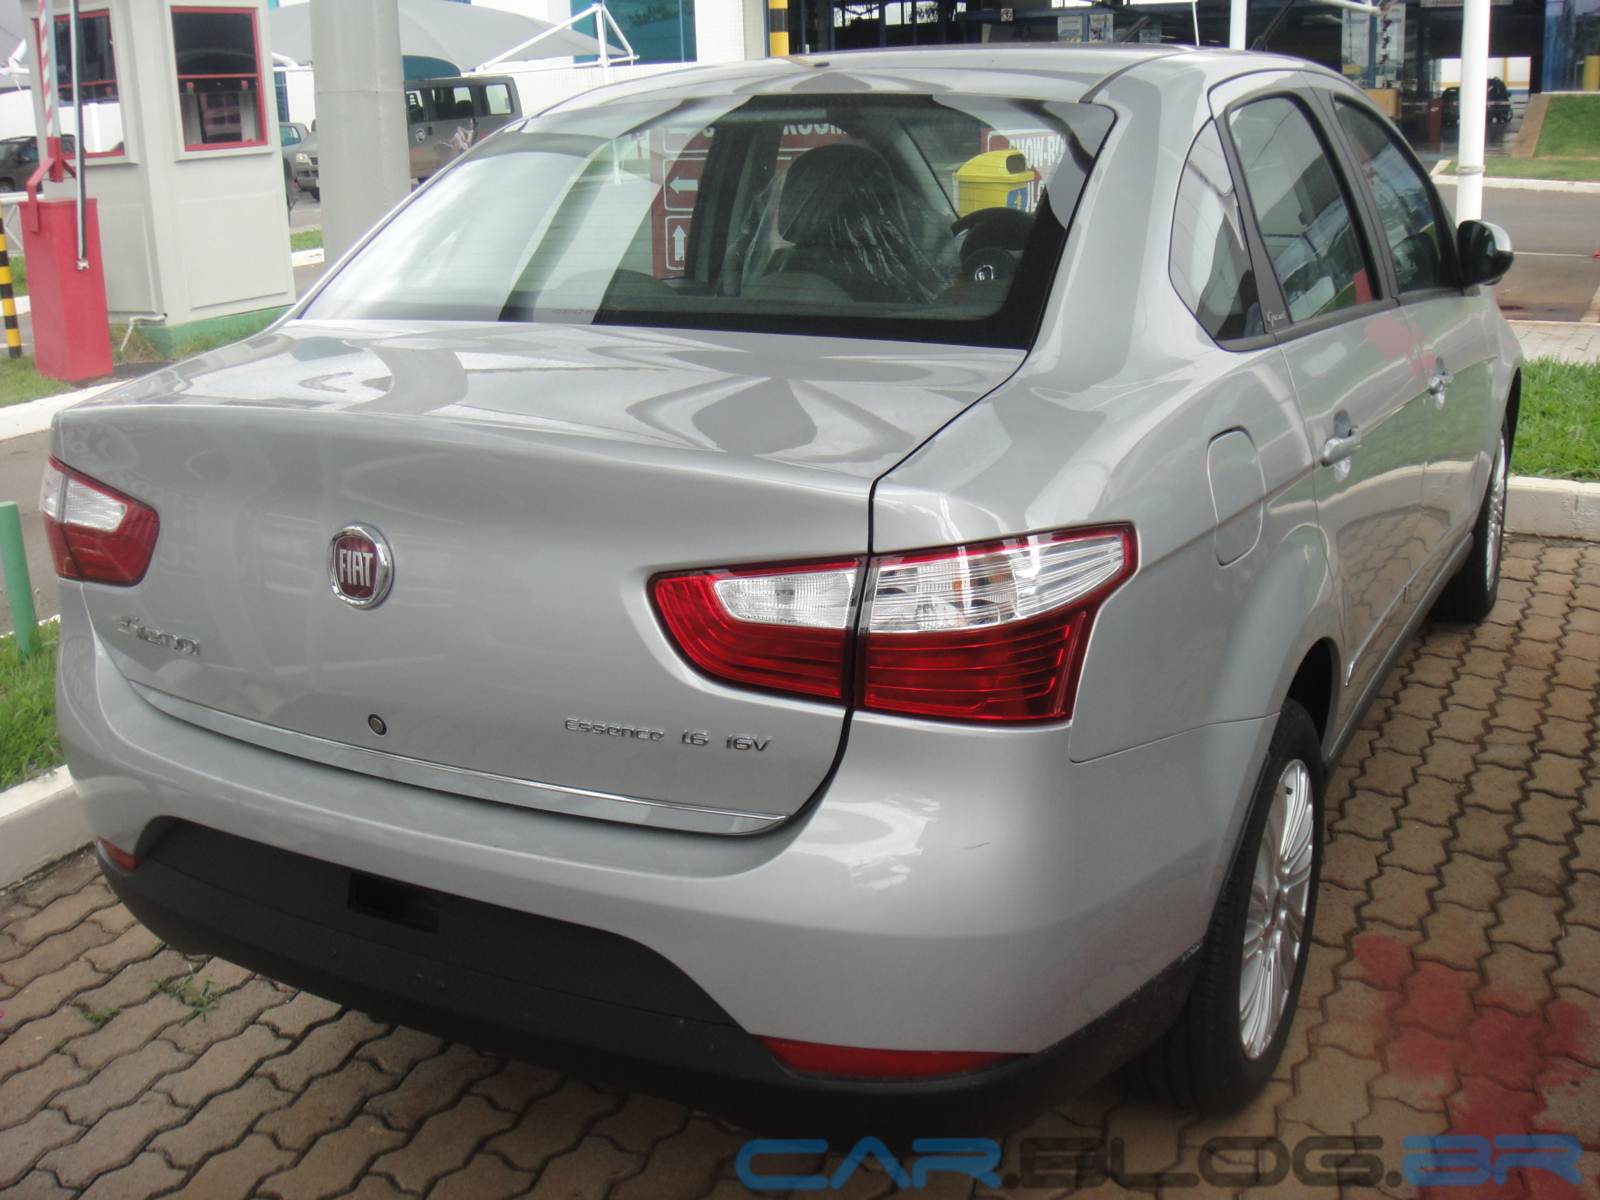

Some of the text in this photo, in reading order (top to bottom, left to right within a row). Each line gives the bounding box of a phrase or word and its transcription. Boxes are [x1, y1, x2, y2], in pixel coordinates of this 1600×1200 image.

[339, 549, 374, 587] FIAT
[564, 716, 665, 742] Essence
[725, 733, 772, 752] 16V
